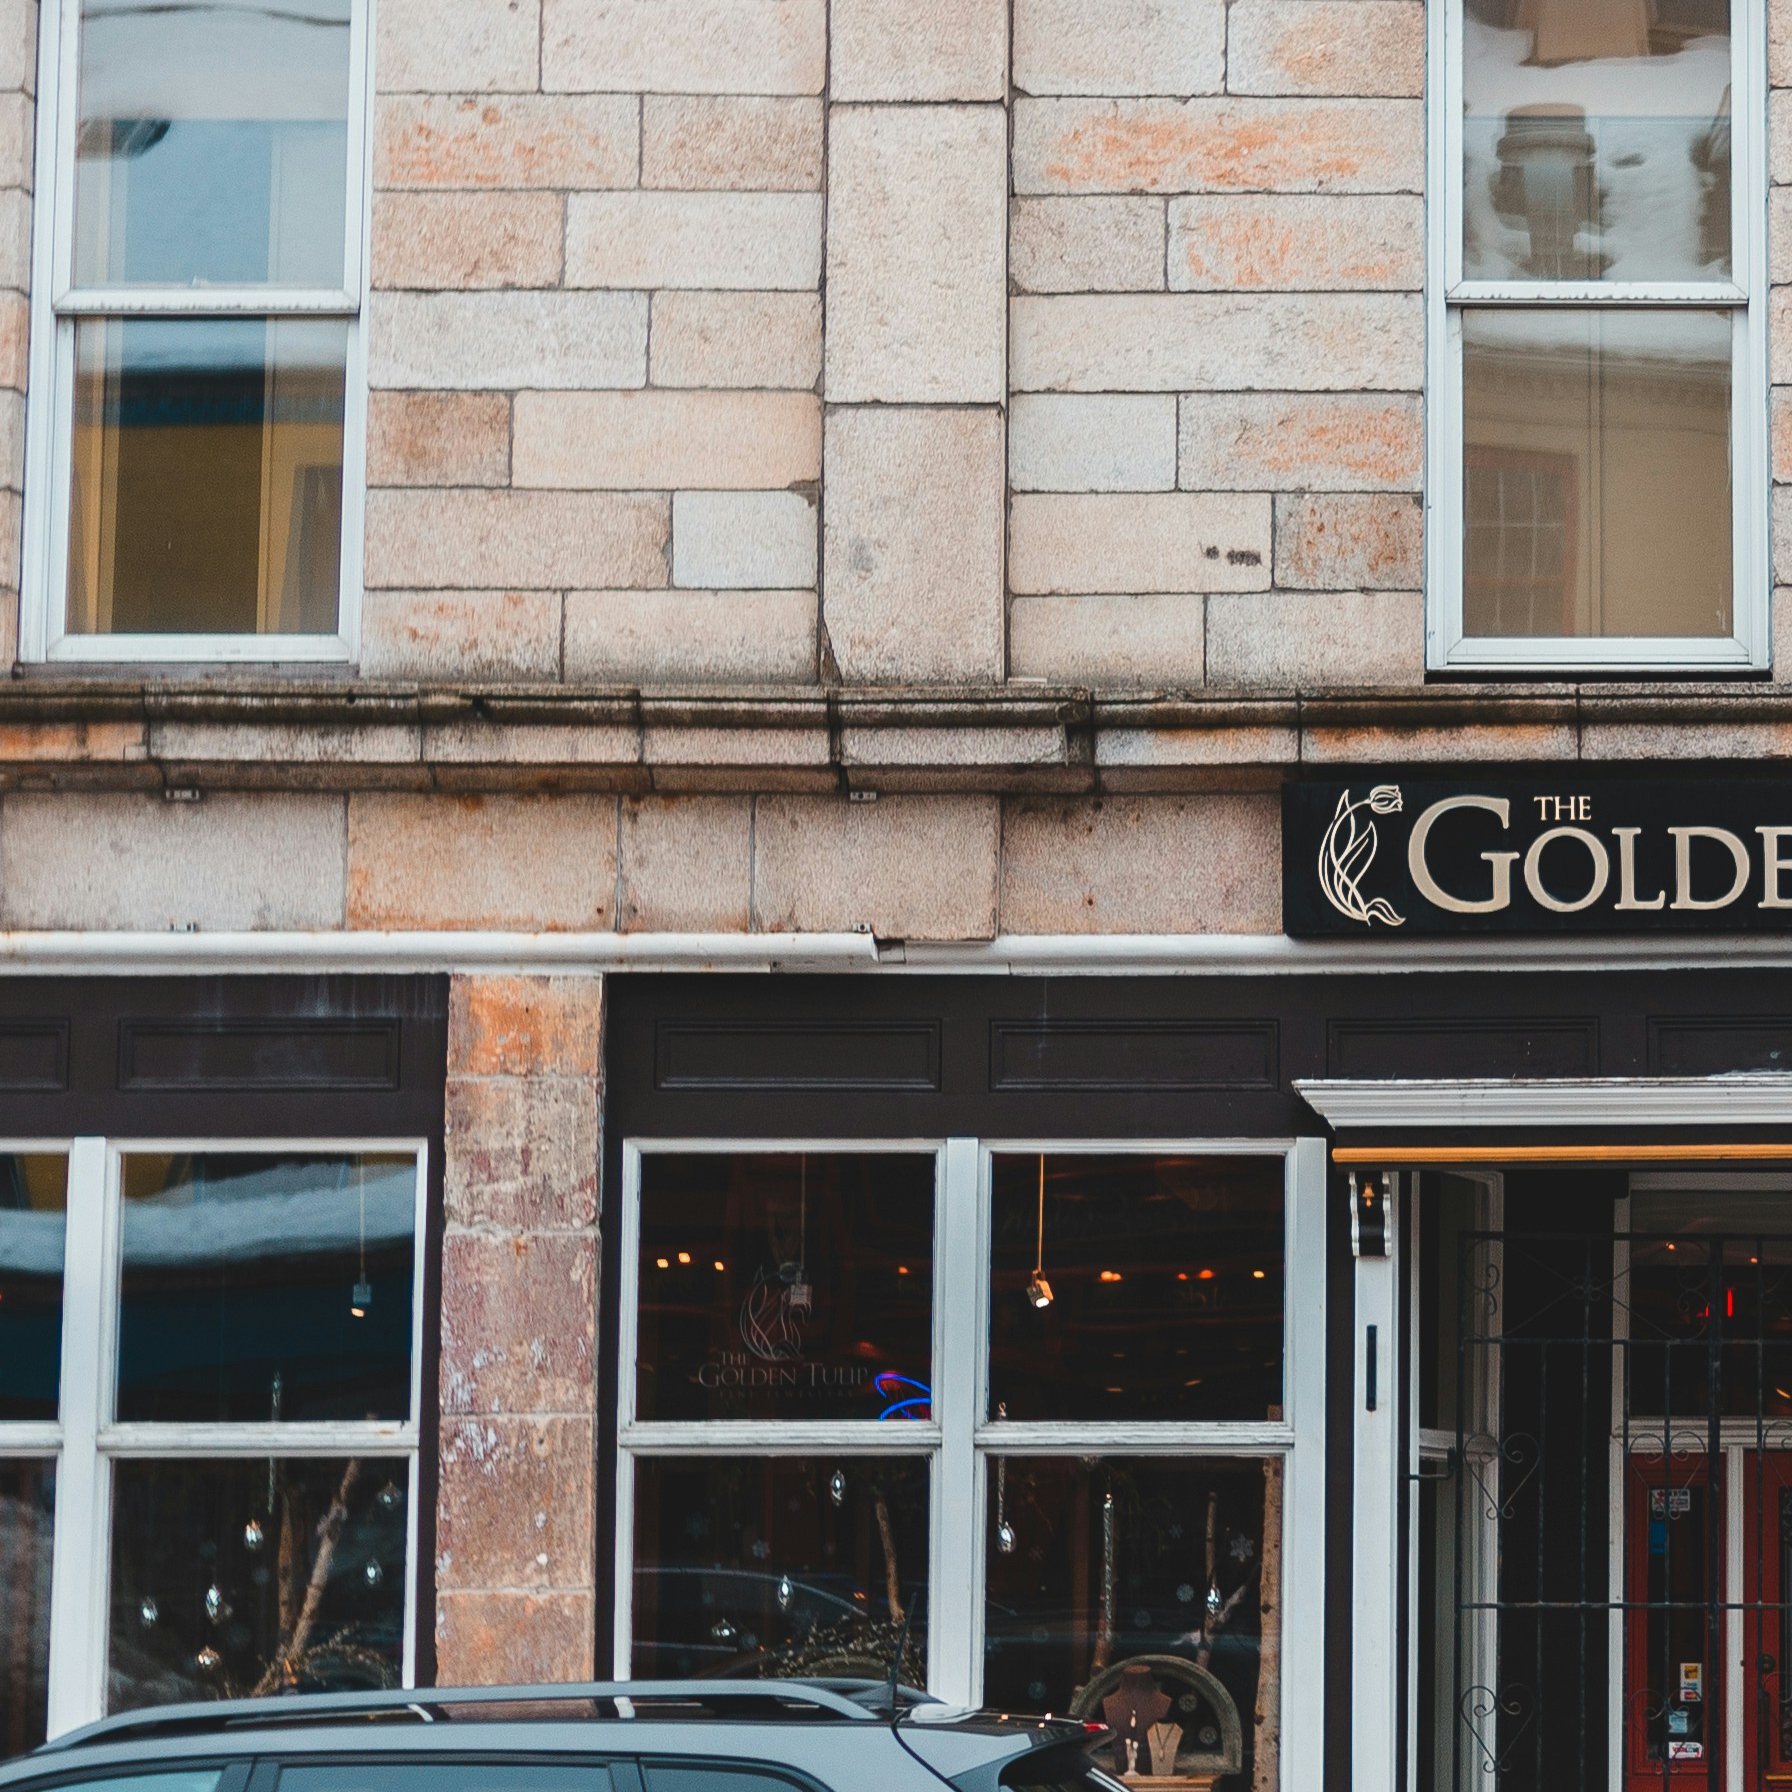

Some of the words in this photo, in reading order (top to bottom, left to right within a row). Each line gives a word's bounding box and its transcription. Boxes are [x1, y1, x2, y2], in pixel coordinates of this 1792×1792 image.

[1533, 795, 1592, 821] THE
[698, 1362, 797, 1388] GOLDEN
[803, 1362, 869, 1388] TULIP
